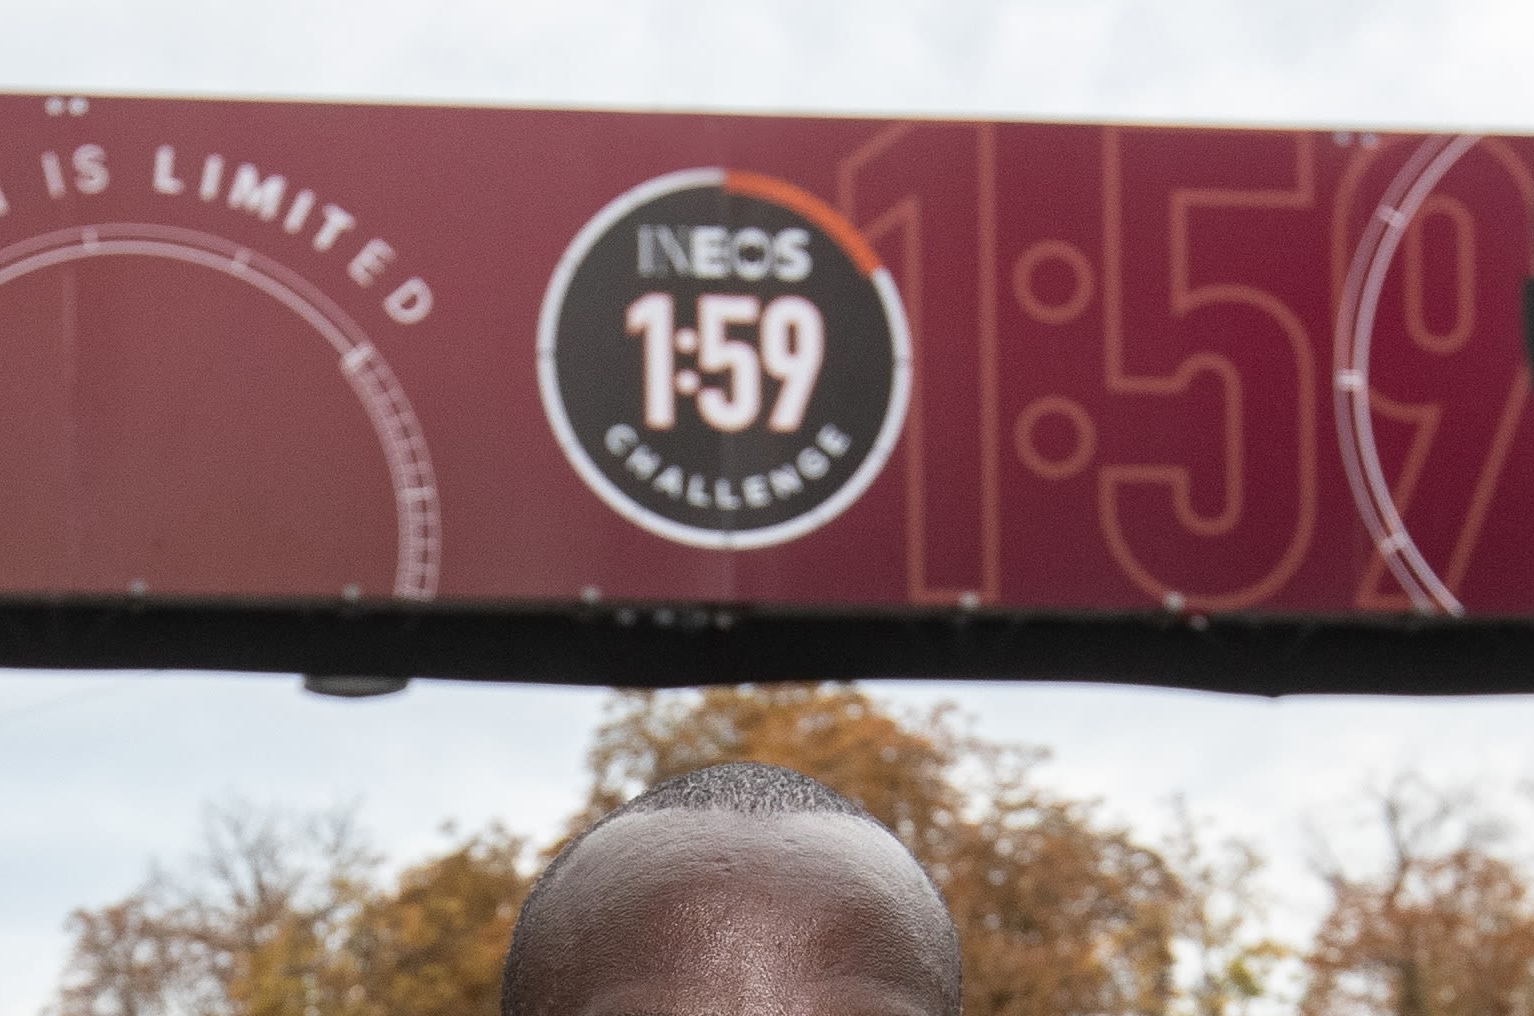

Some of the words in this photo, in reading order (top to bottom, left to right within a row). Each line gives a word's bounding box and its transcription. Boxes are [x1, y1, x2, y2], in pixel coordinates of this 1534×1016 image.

[39, 143, 111, 197] IS
[153, 143, 435, 327] LIMITED
[635, 223, 813, 281] INEOS
[623, 290, 825, 434] 1:59
[603, 422, 851, 512] CHALLENGE
